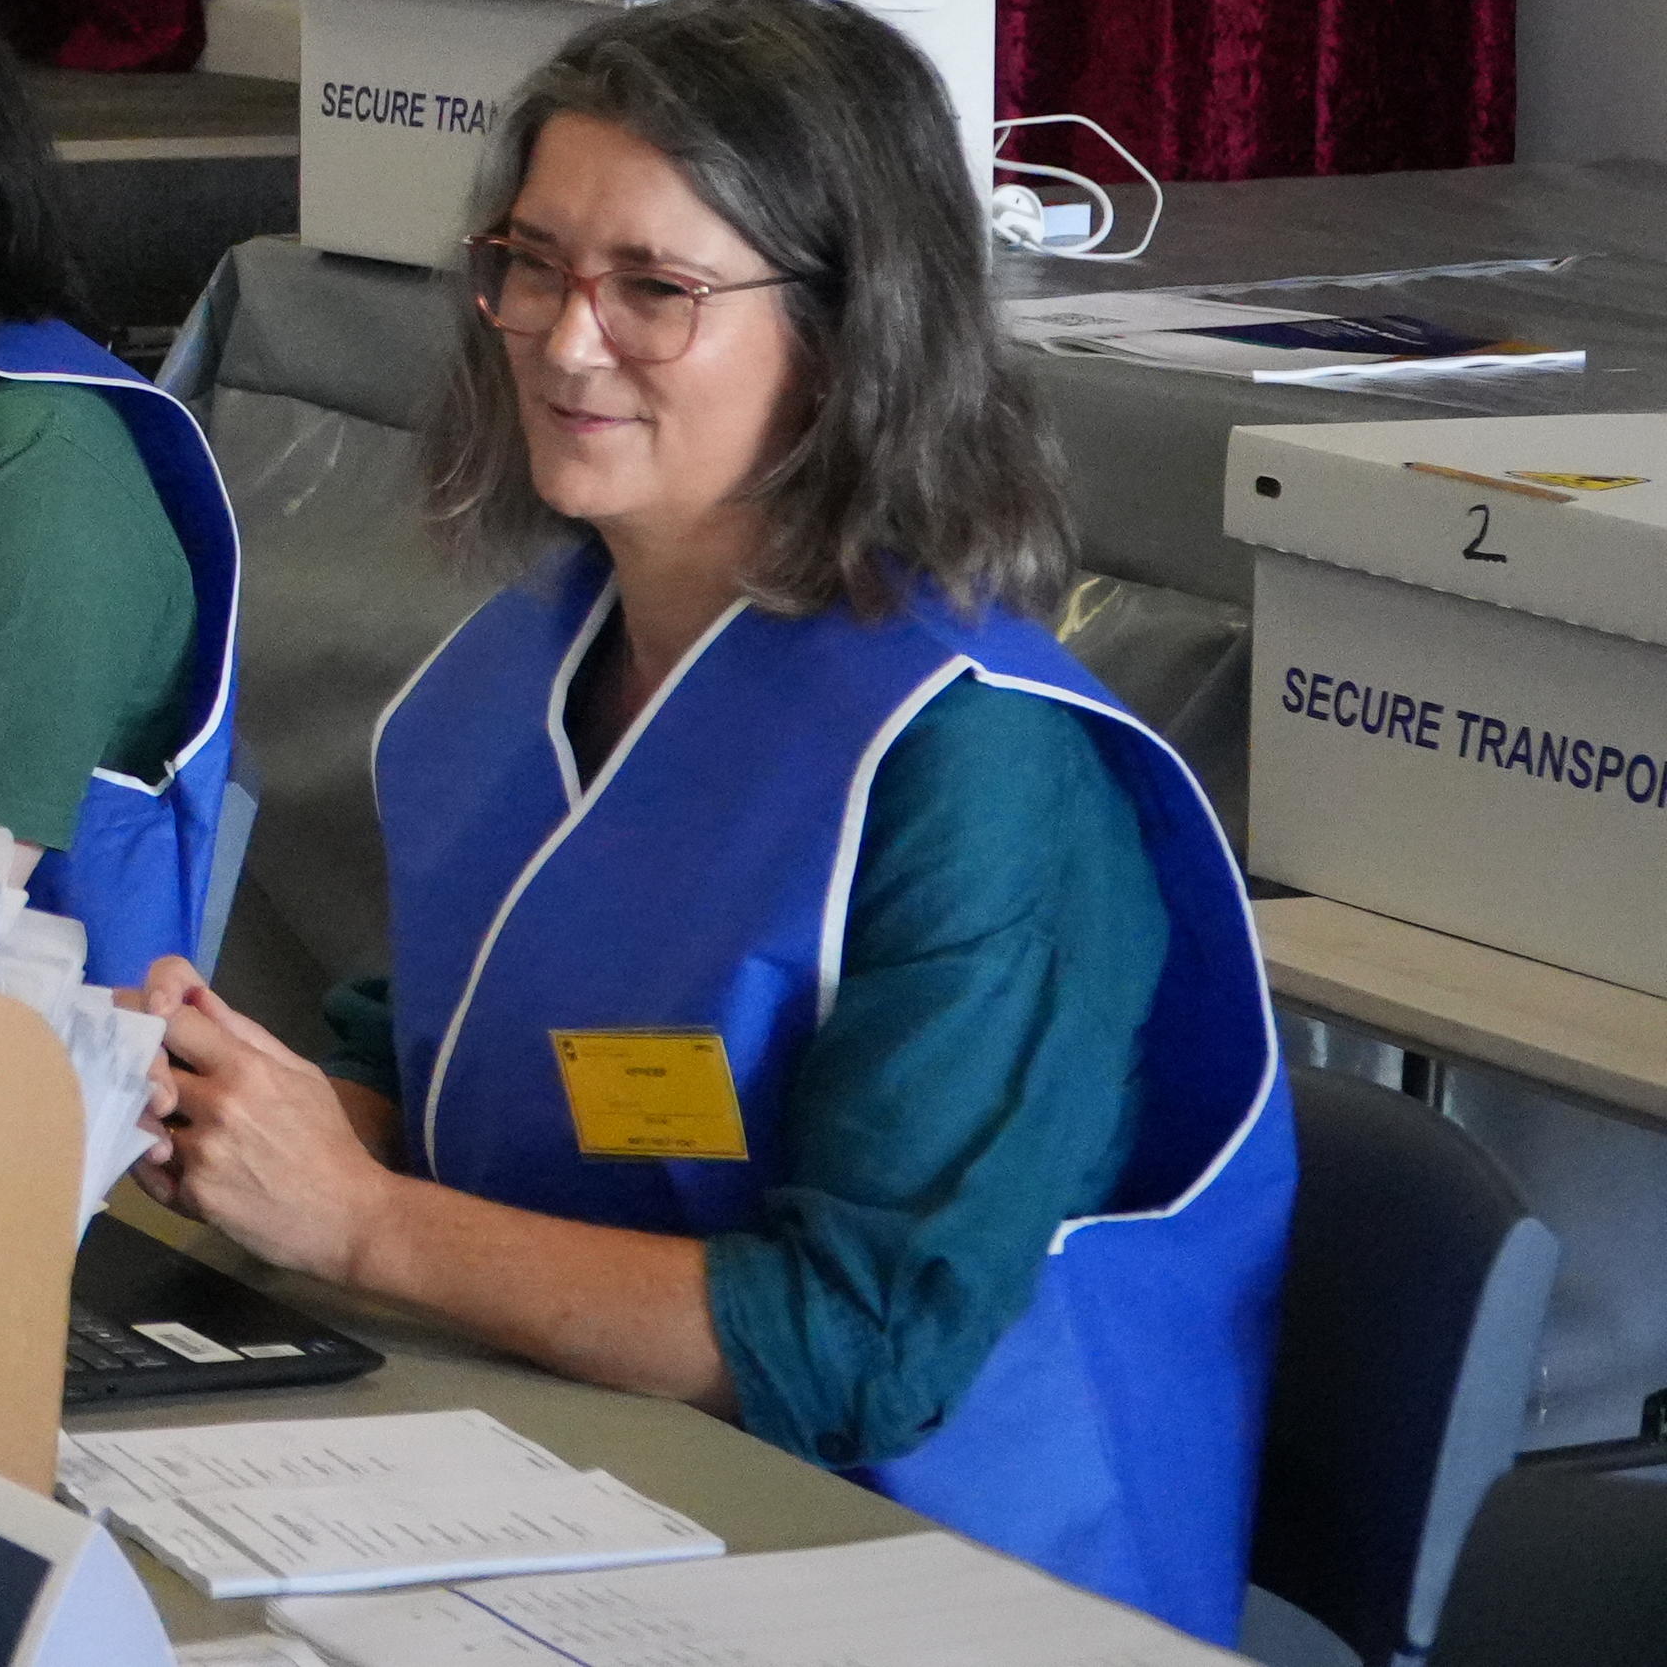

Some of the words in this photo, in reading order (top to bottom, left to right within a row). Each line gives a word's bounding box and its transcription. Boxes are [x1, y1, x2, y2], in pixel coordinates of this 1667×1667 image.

[321, 82, 426, 128] SECURE
[1462, 504, 1508, 564] 2
[1282, 666, 1445, 751] SECURE
[1457, 709, 1667, 809] TRANSPO
